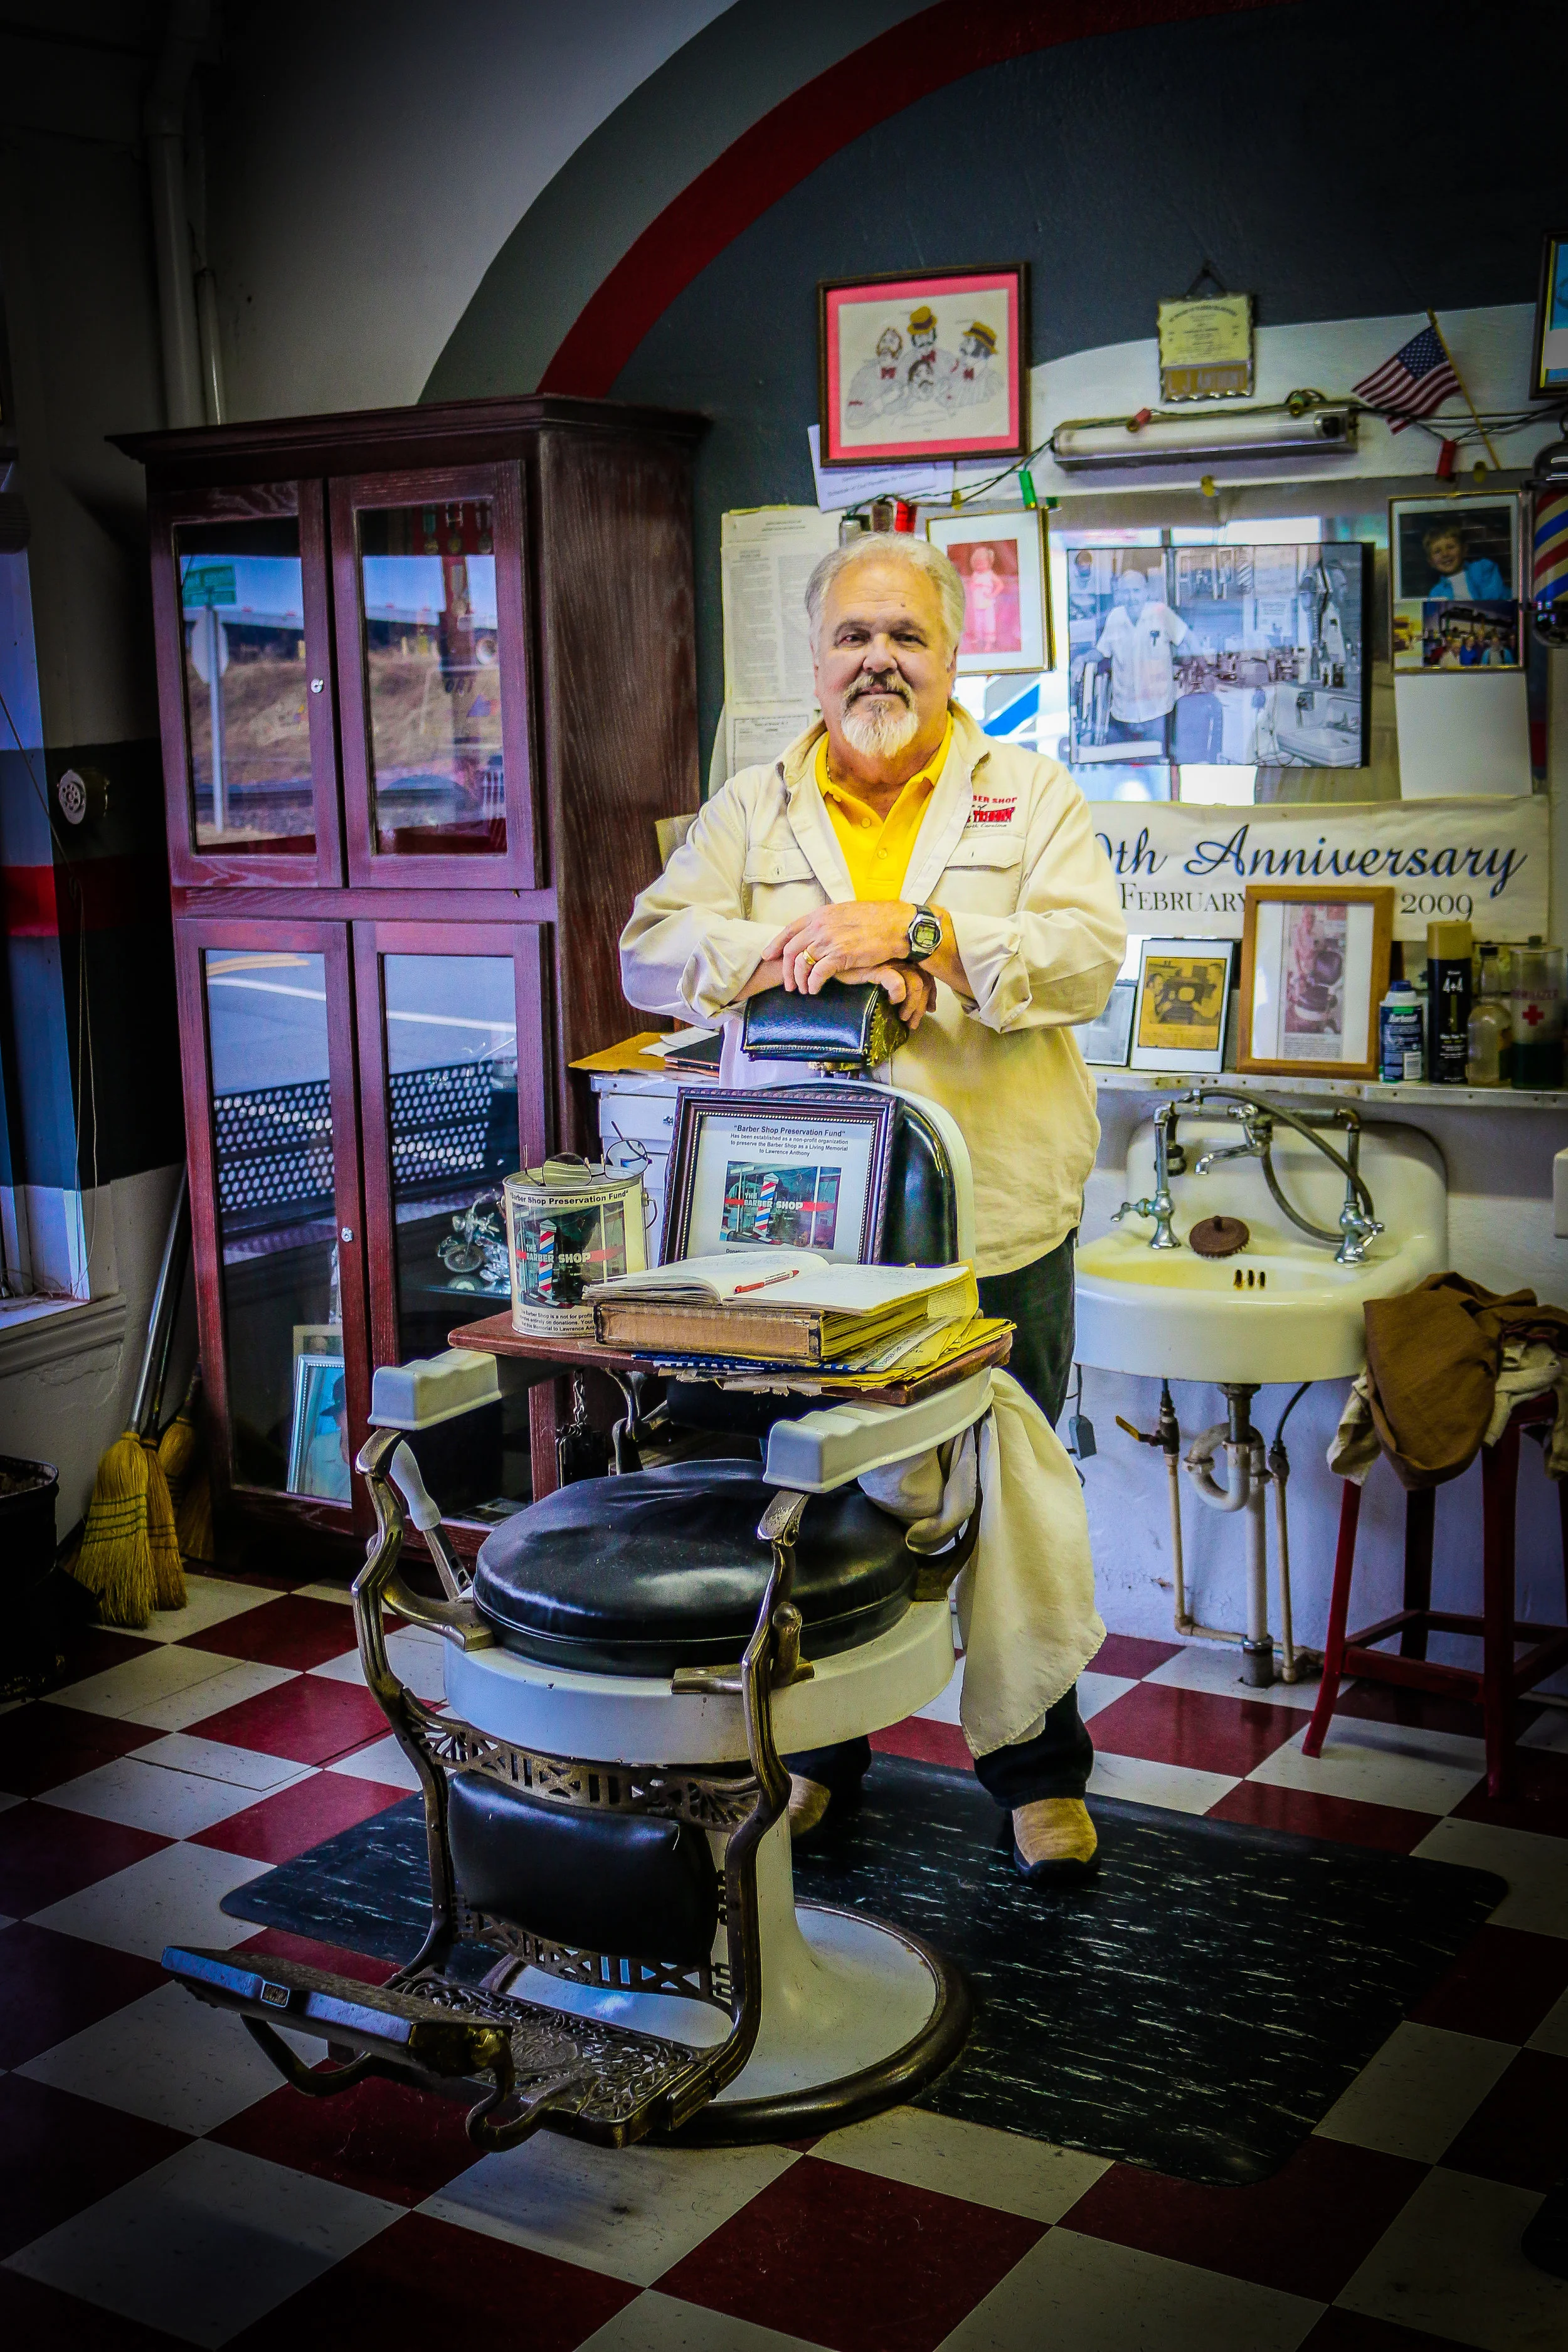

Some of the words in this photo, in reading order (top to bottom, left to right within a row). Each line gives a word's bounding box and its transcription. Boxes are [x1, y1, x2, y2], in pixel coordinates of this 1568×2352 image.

[973, 795, 989, 803] BER
[1183, 823, 1528, 899] Anniversary
[1400, 893, 1474, 922] 2009
[761, 1126, 778, 1135] Shop
[780, 1127, 823, 1136] Preservation
[527, 1196, 546, 1206] Shop
[549, 1194, 607, 1205] Preservation
[744, 1199, 773, 1208] BARBER
[776, 1200, 803, 1210] SHOP
[526, 1244, 537, 1253] THE
[526, 1253, 554, 1263] BARBER
[558, 1253, 591, 1264] SHOP
